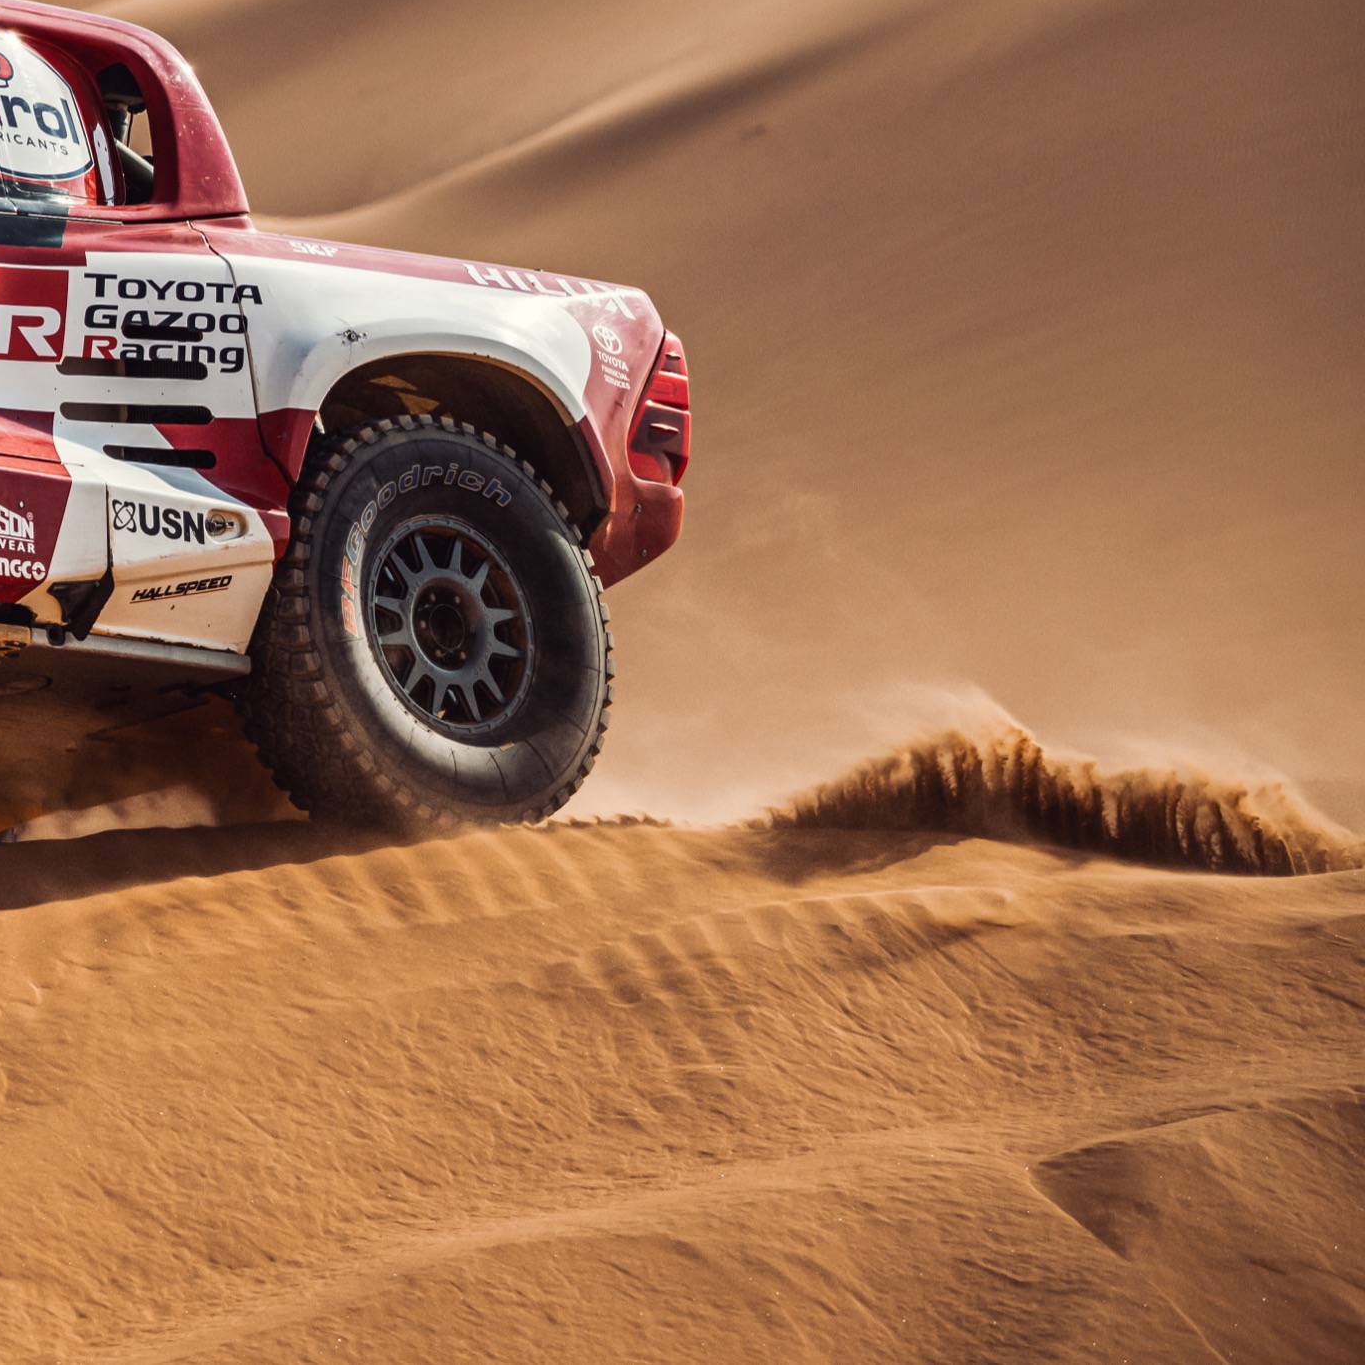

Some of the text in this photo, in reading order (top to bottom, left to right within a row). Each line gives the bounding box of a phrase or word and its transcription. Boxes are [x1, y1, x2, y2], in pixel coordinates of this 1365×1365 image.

[288, 241, 339, 257] SKF
[83, 272, 263, 305] TOYOTA
[82, 335, 245, 373] Racing
[596, 350, 629, 372] TOYOTA
[138, 503, 206, 545] USN
[340, 463, 512, 636] BFGoodrich
[131, 575, 233, 601] HALLSPEED
